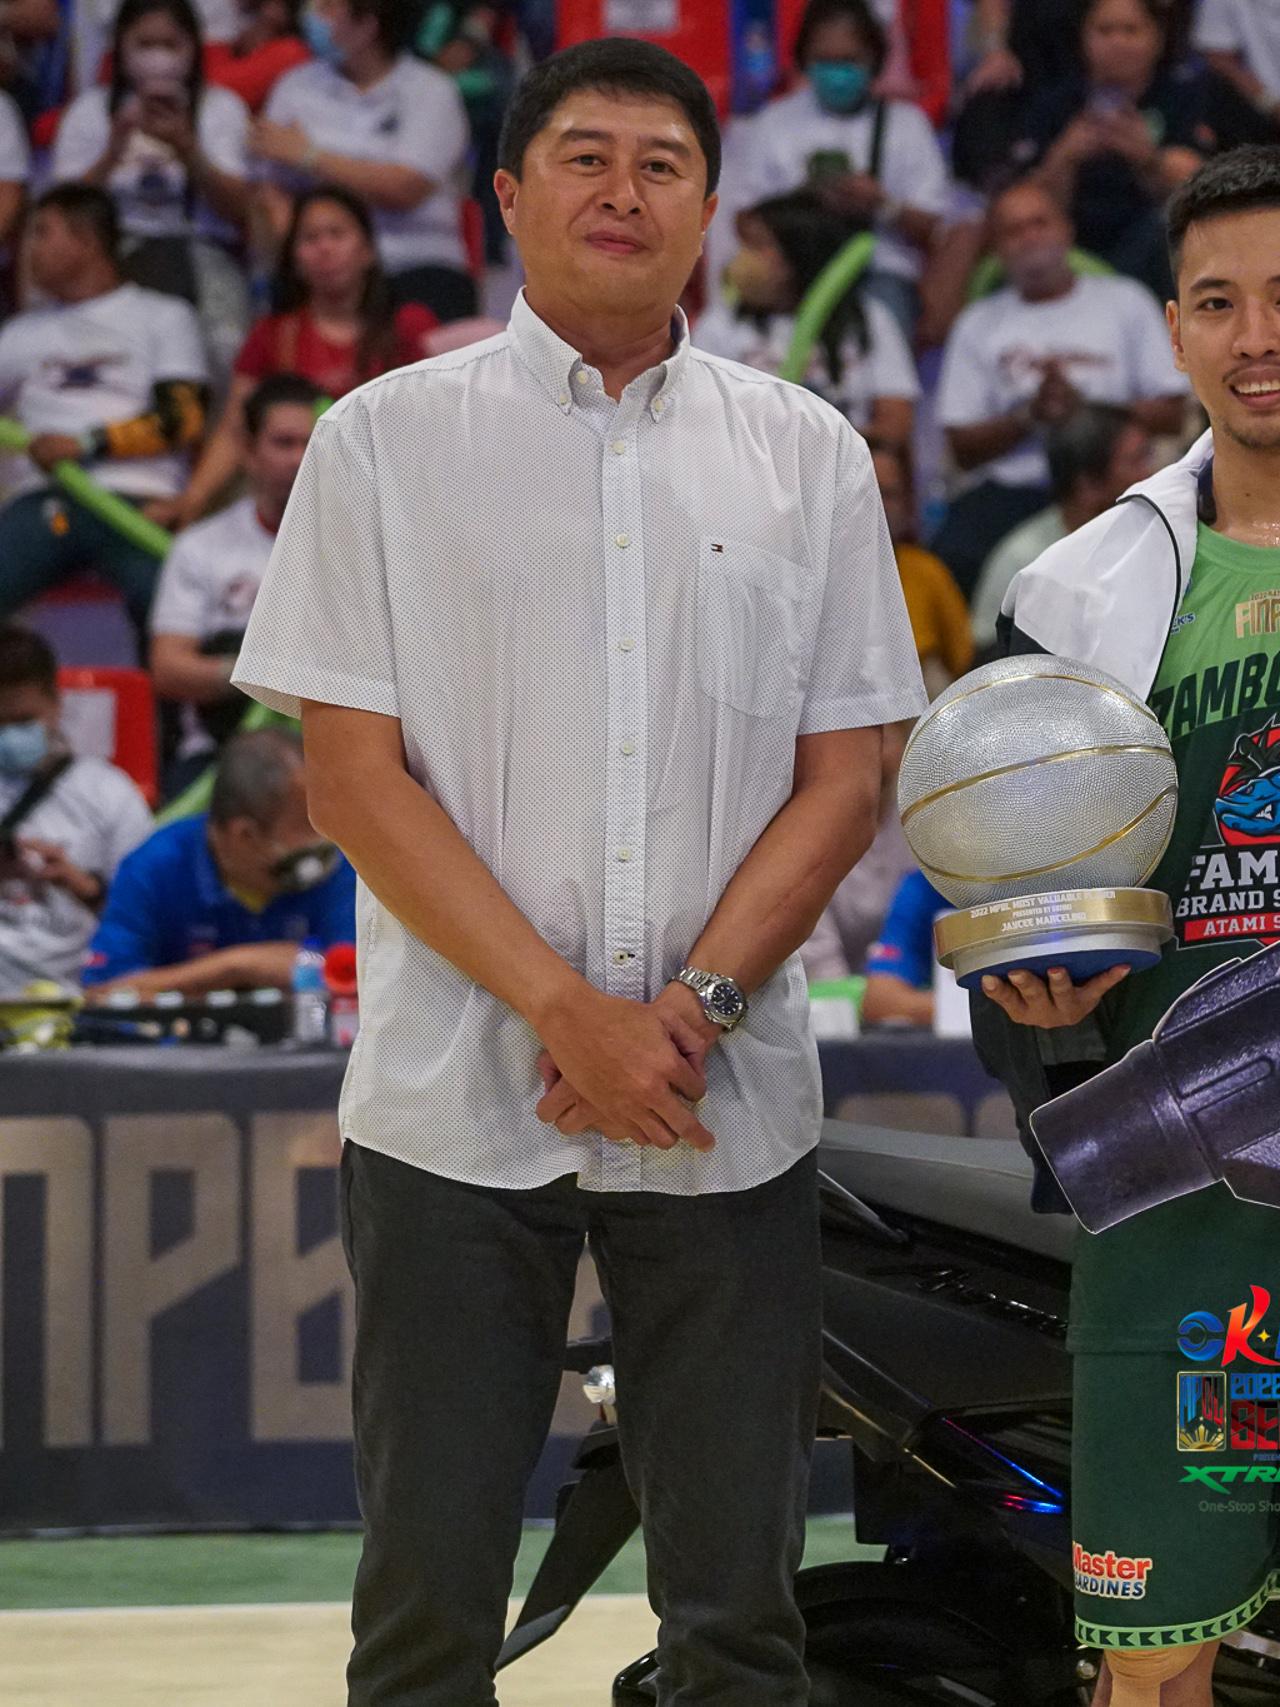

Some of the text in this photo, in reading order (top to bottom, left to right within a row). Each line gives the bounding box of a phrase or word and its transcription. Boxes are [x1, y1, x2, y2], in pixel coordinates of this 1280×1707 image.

[970, 908, 989, 919] 2022
[1012, 897, 1037, 909] MOST
[1037, 892, 1082, 905] VALUABLE
[1175, 889, 1266, 918] BRAND
[1203, 916, 1265, 937] ATAMI
